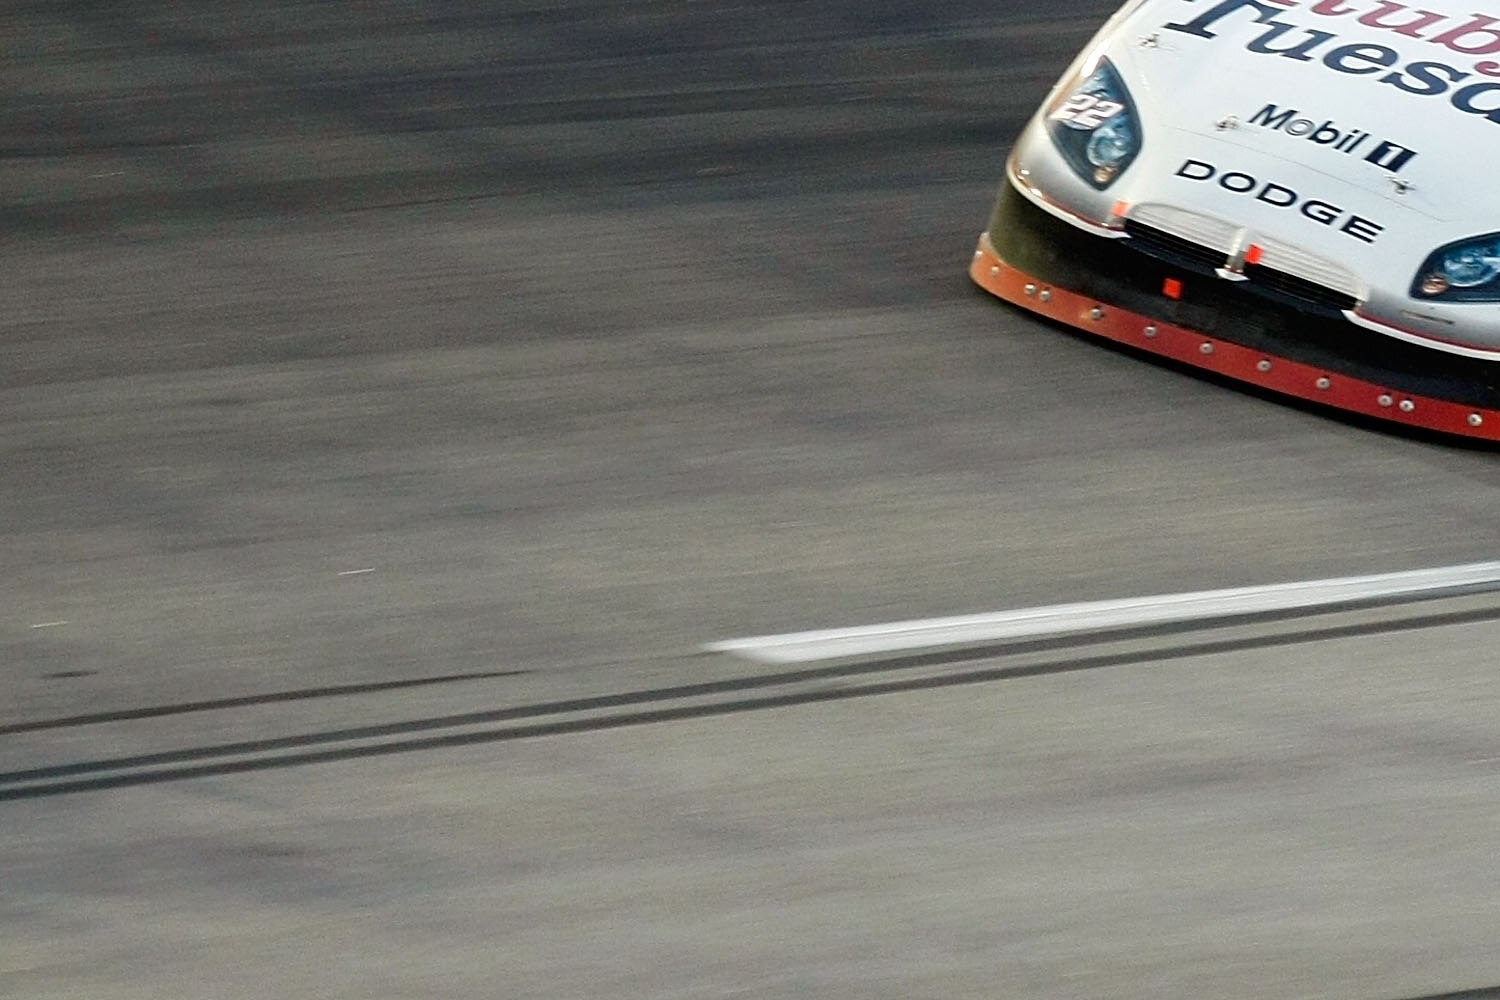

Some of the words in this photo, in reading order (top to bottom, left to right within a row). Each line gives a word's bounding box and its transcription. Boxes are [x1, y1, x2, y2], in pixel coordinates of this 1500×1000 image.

[1048, 93, 1126, 131] 22
[1246, 102, 1374, 155] Mobil
[1362, 139, 1419, 174] 1
[1173, 158, 1386, 244] DODGE
